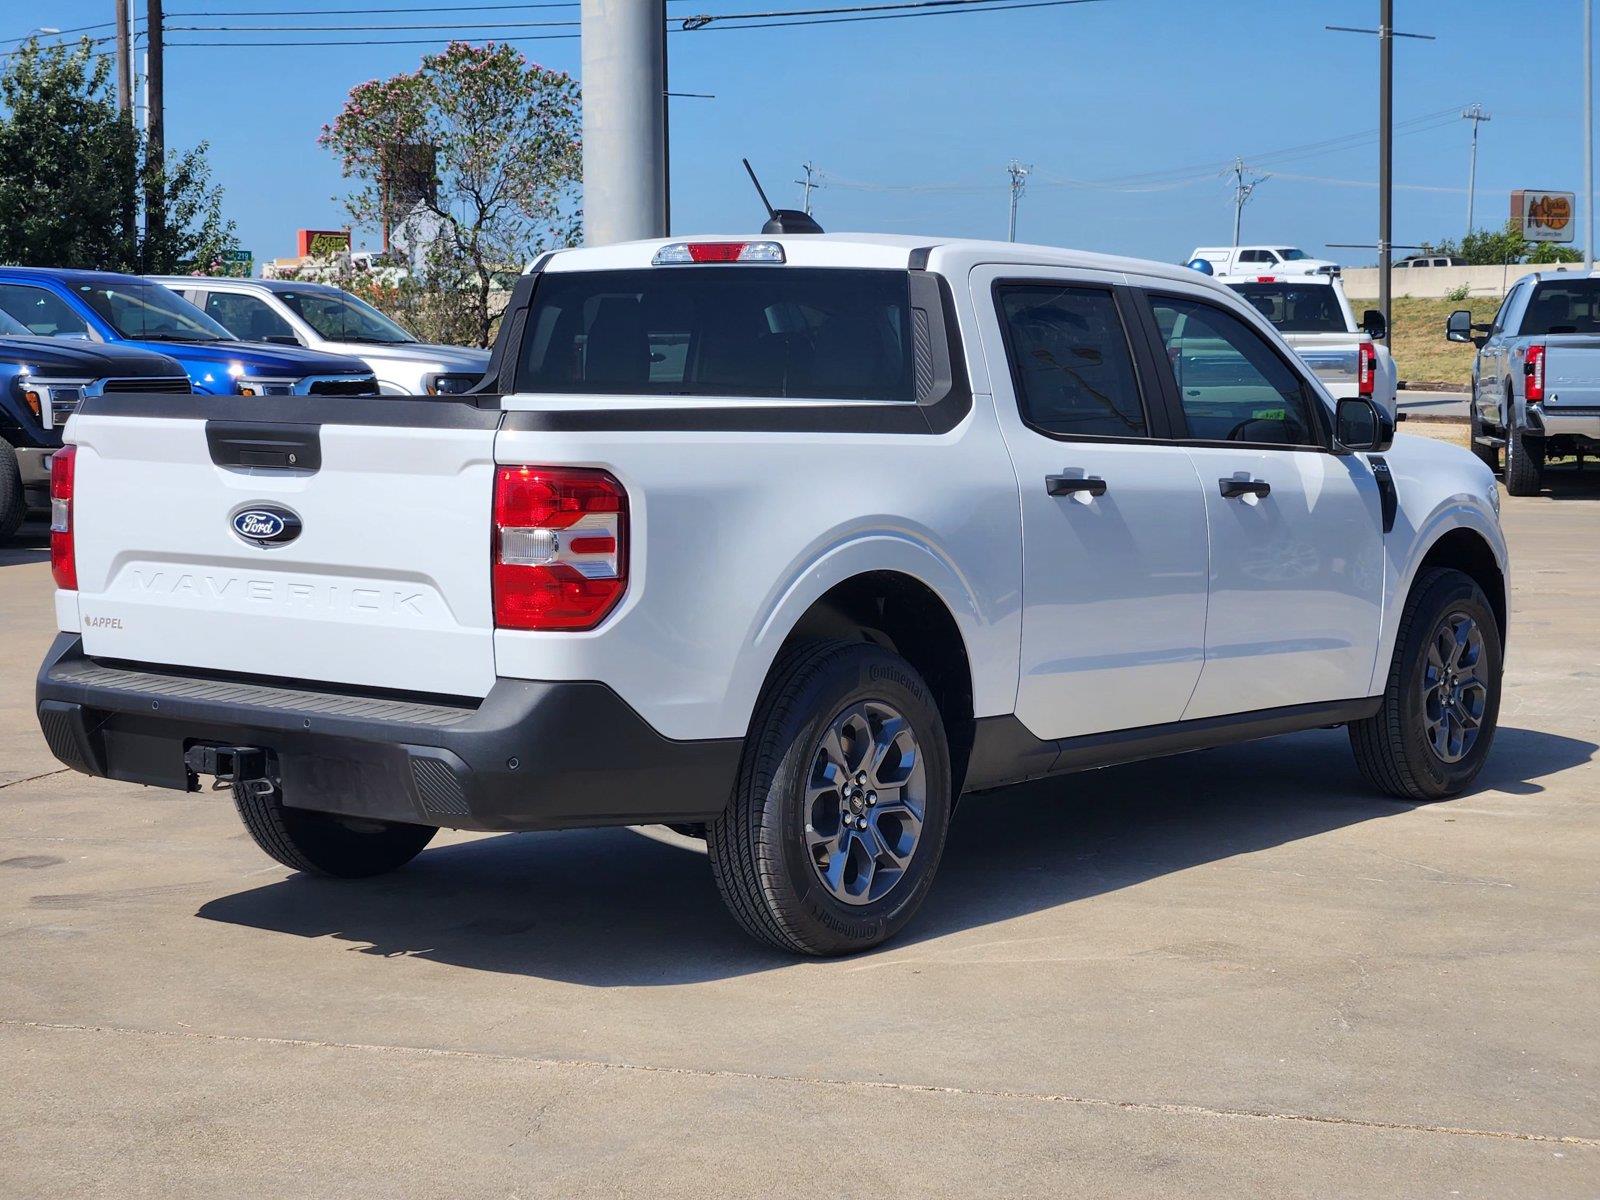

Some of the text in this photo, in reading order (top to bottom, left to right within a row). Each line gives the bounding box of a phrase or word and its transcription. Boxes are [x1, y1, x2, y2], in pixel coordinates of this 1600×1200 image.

[236, 251, 249, 260] 219
[242, 514, 274, 534] Ford
[133, 569, 425, 616] MAVERICK
[91, 616, 124, 629] APPEL
[868, 663, 923, 701] Continental
